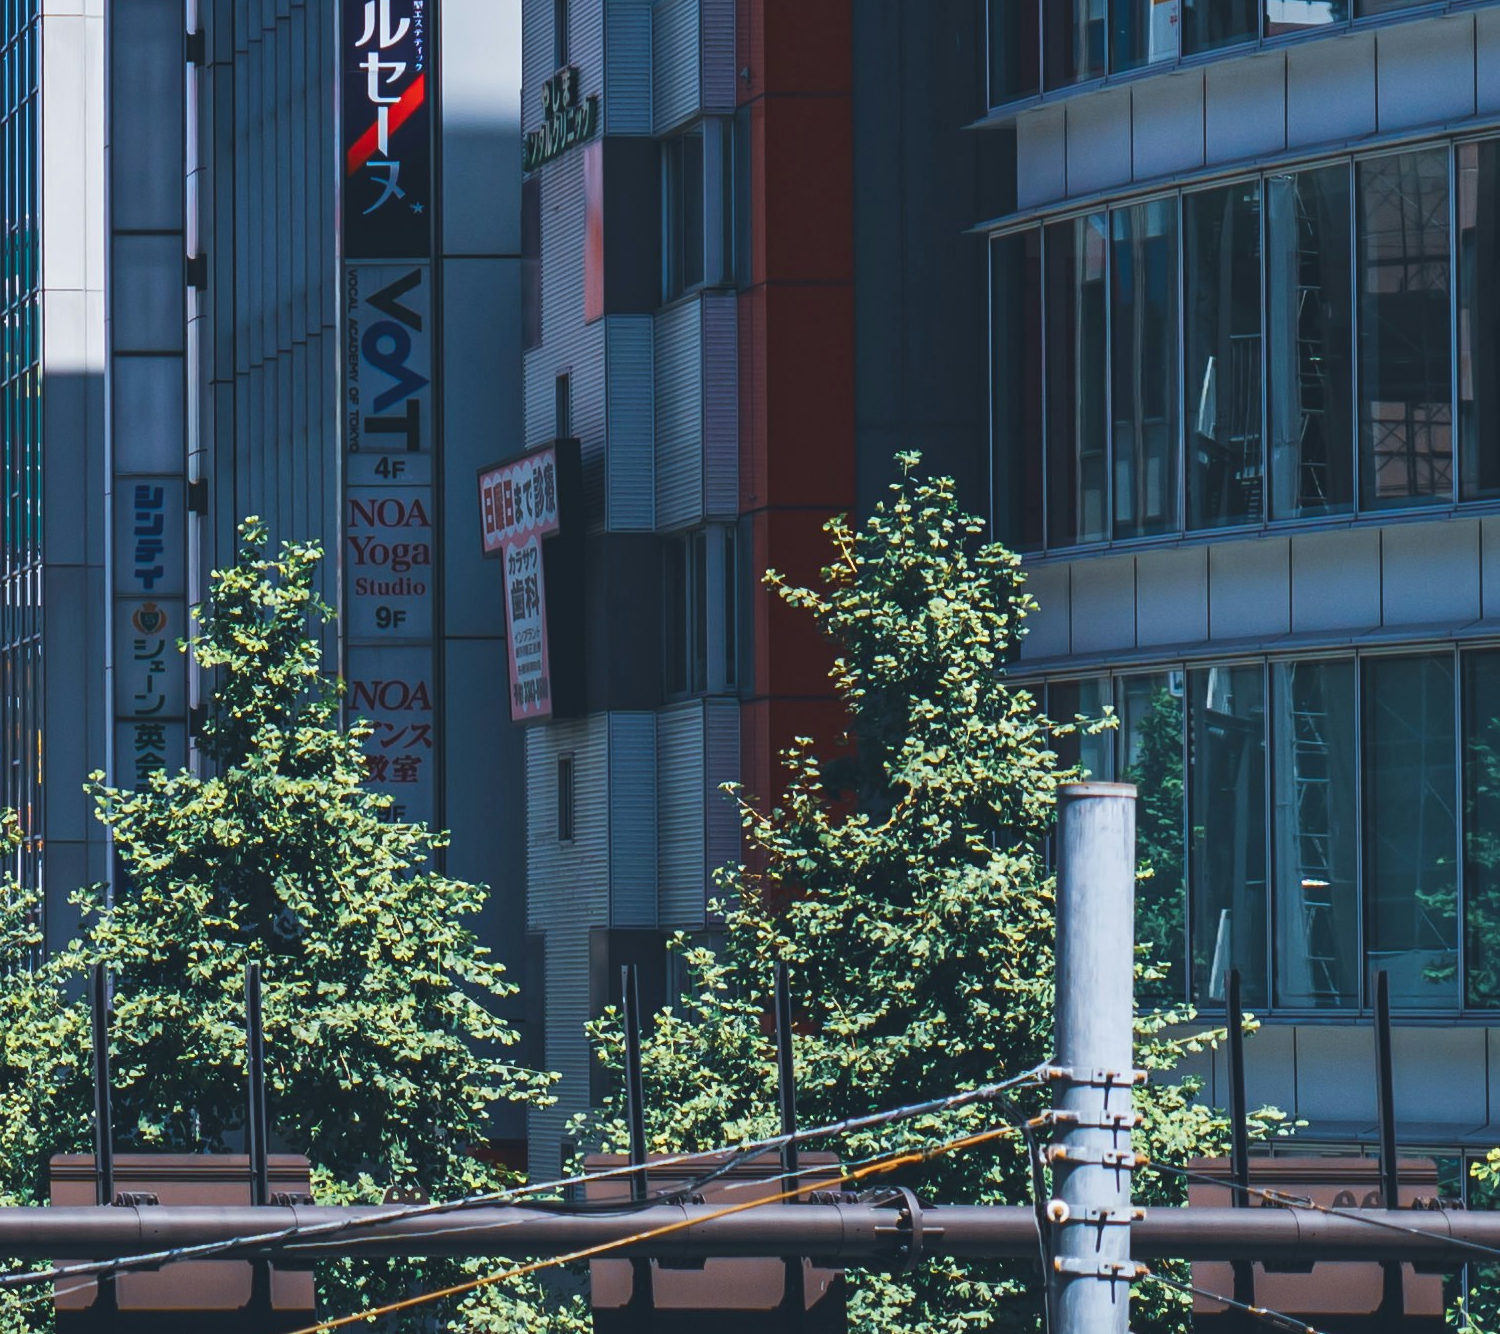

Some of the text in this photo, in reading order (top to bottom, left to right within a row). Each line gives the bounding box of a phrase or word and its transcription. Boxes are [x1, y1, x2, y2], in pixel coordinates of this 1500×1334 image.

[526, 98, 592, 166] ンタルクリニック
[347, 268, 361, 453] VOCAL ACADEMY OF TOKYO
[362, 268, 431, 452] VOAT
[373, 456, 407, 480] 4F
[347, 498, 431, 528] NOA
[483, 461, 557, 535] 日曜日まで診療
[350, 534, 432, 572] Yoga
[508, 546, 538, 576] カラサワ
[354, 576, 427, 598] Studio
[510, 573, 541, 622] 歯科
[374, 606, 407, 630] 9F
[133, 637, 167, 788] シェーン 英会
[350, 680, 433, 712] NOA
